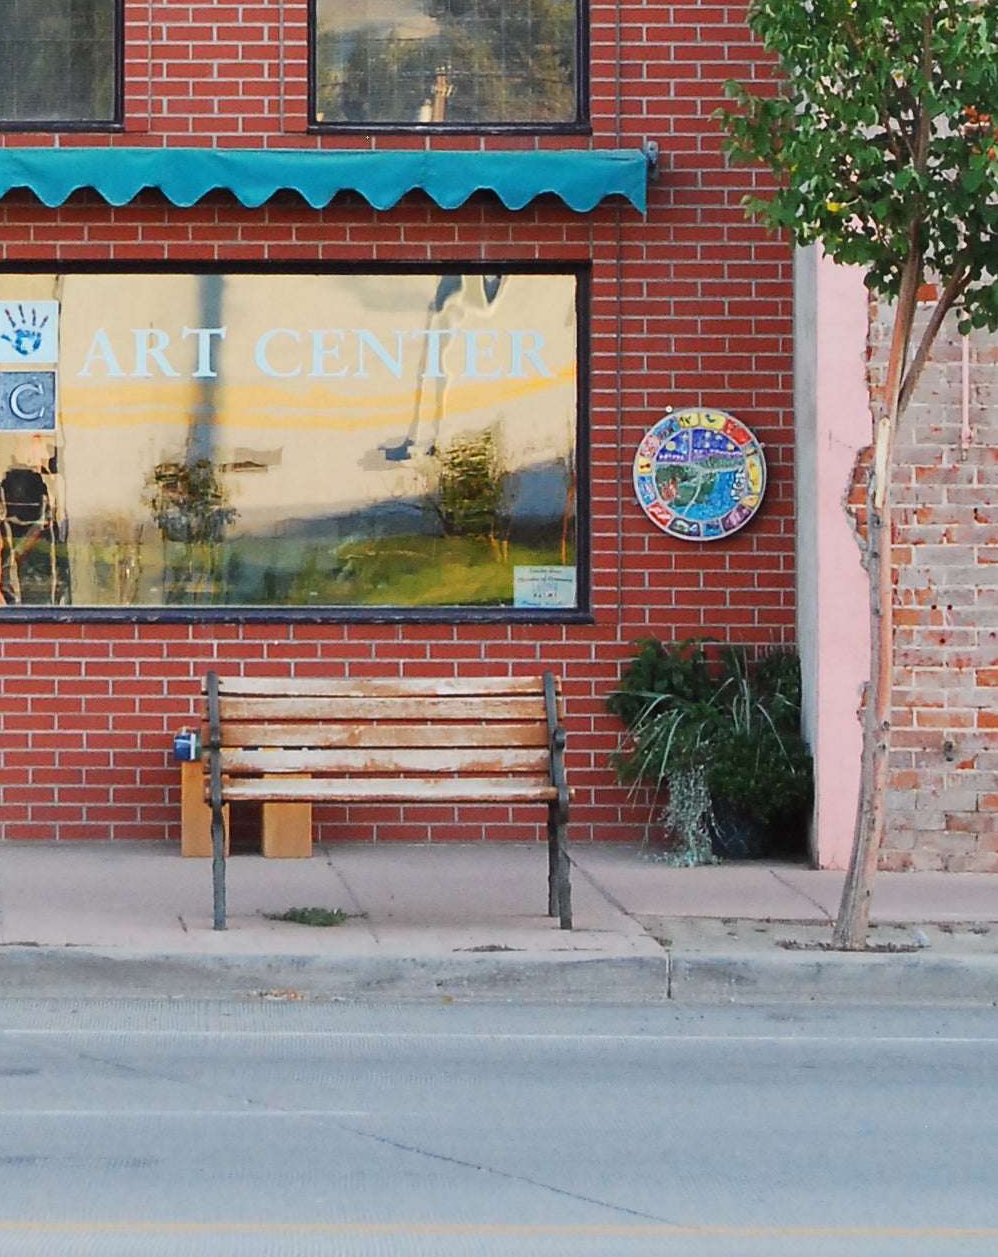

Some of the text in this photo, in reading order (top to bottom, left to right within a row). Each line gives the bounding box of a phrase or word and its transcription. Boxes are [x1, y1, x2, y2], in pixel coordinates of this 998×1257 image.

[76, 325, 557, 380] ART CENTER
[8, 382, 45, 421] C
